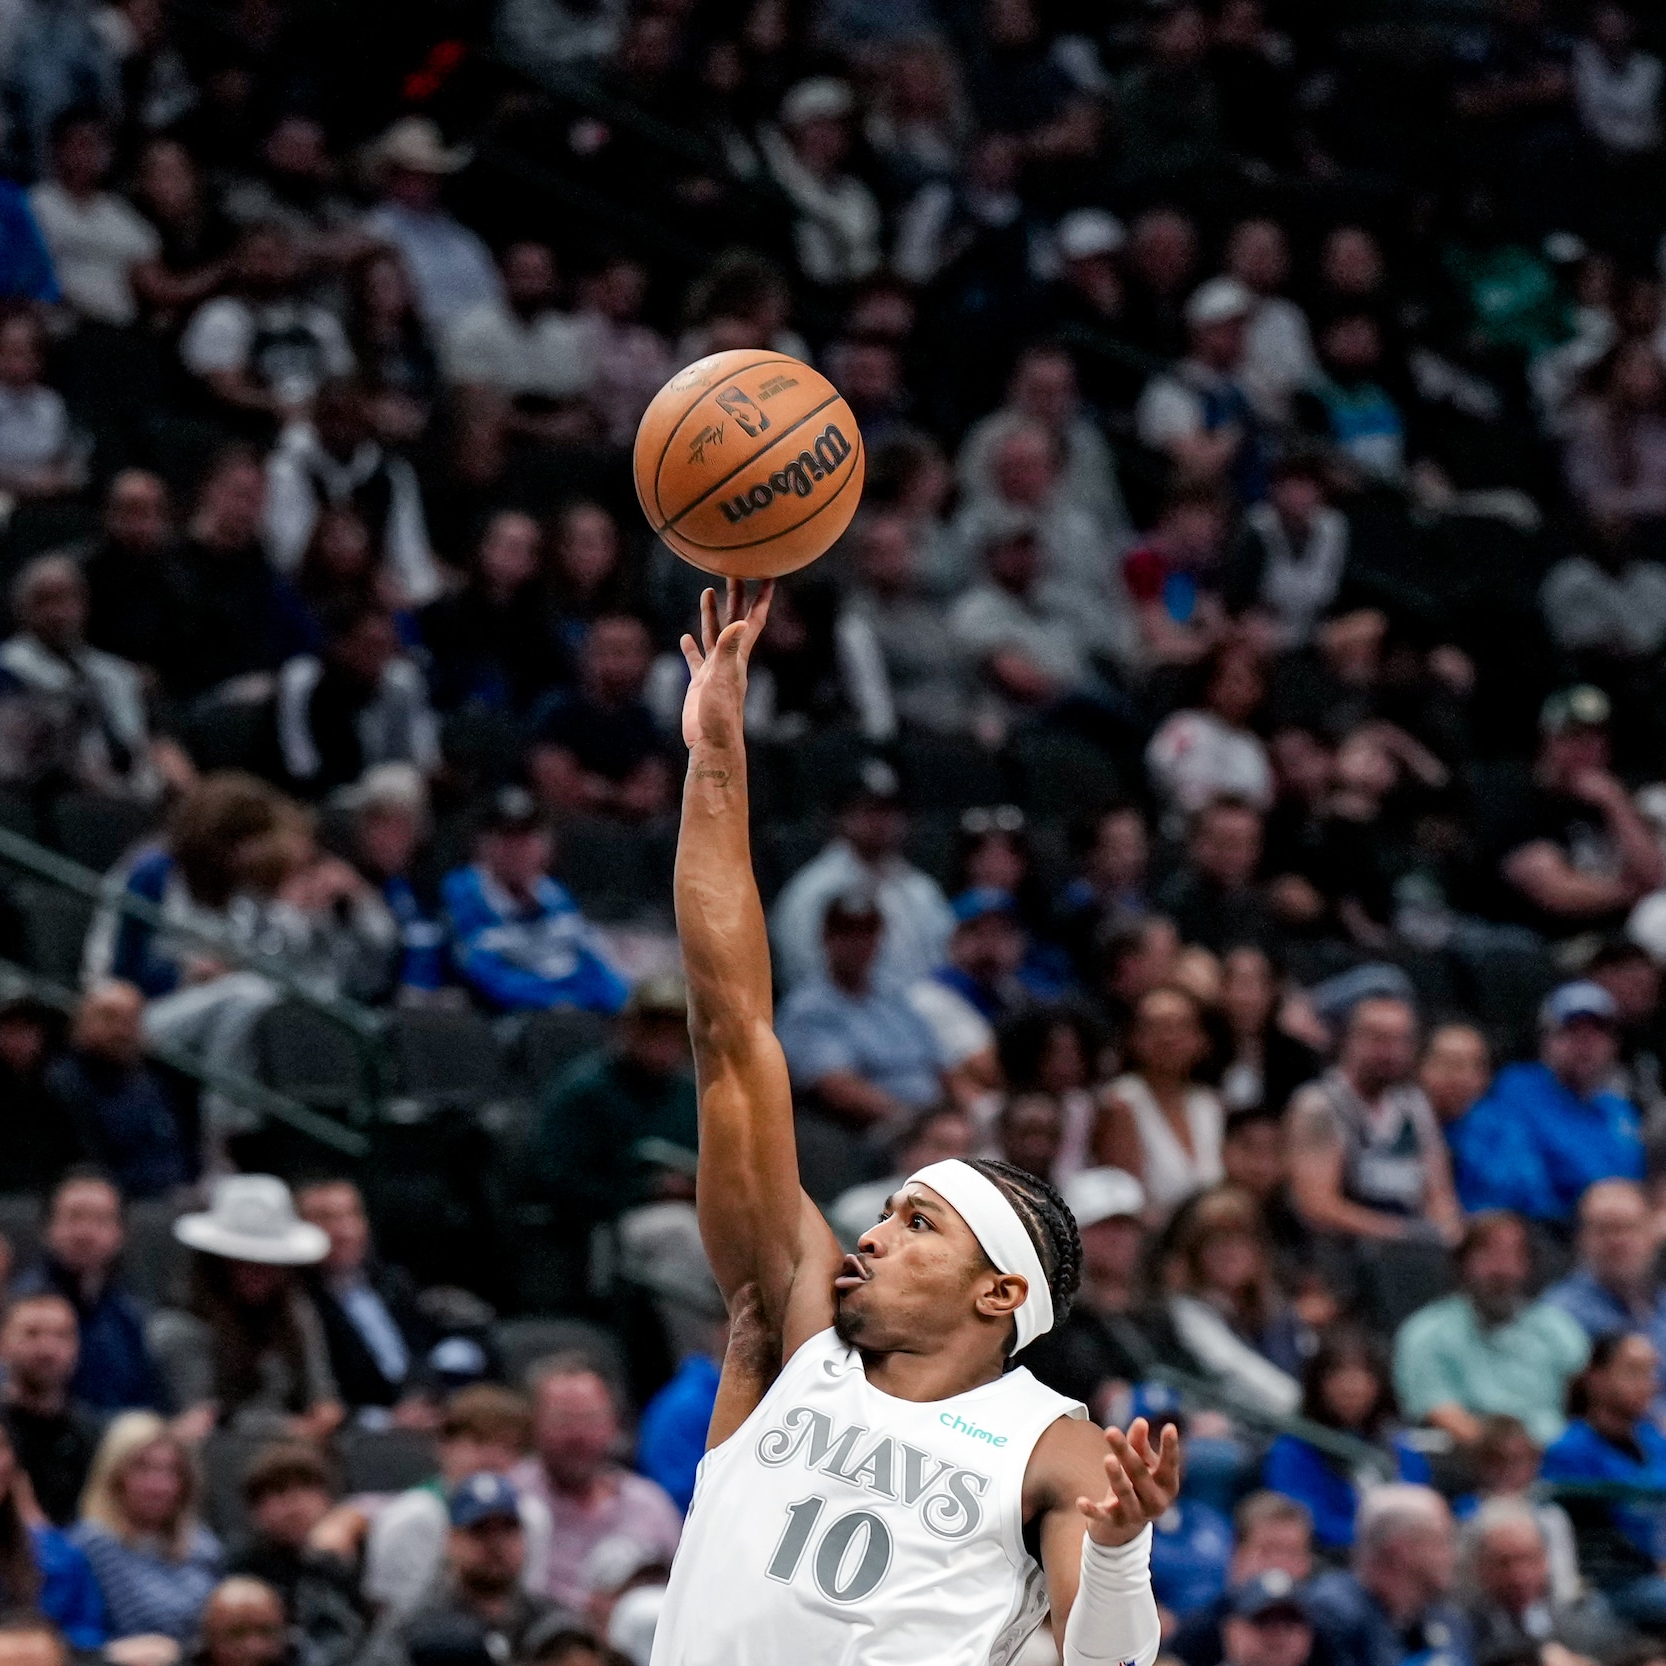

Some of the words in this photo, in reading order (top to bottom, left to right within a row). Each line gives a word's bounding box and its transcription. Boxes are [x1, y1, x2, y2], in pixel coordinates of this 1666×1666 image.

[719, 423, 851, 523] Wilson
[756, 1406, 992, 1542] MAVS
[939, 1412, 1008, 1448] chime
[764, 1493, 894, 1606] 10
